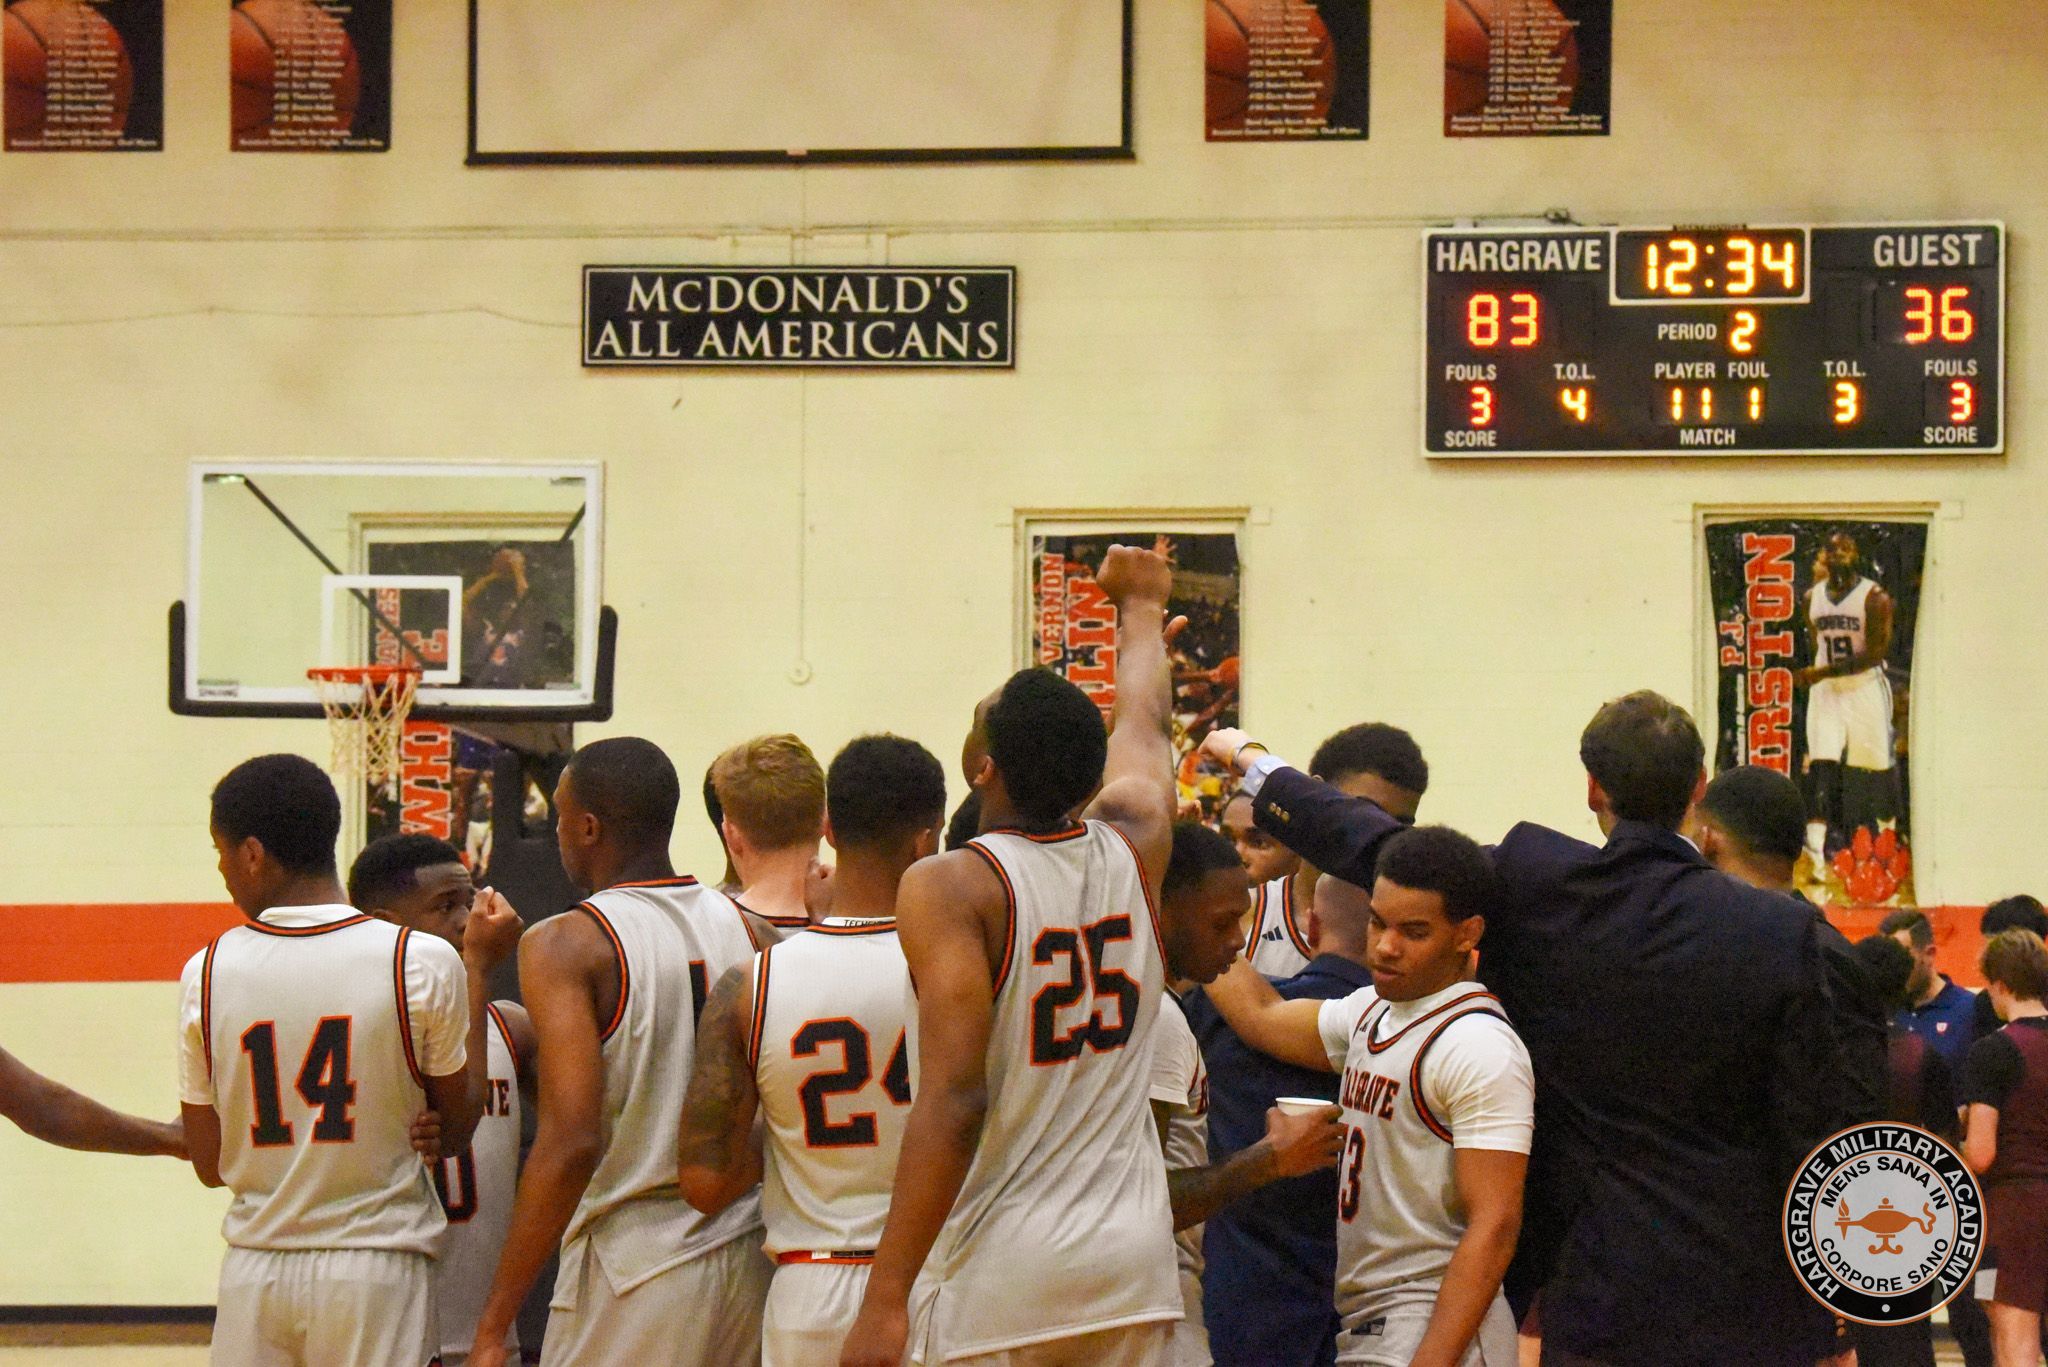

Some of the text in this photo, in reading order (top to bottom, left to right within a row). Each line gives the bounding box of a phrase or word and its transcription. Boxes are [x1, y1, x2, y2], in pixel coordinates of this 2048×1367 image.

[1436, 238, 1601, 273] HARGRAVE
[1646, 239, 1794, 293] 12:34
[1873, 233, 1983, 267] GUEST
[625, 274, 969, 314] McDONALD'S
[1468, 293, 1538, 347] 83
[1658, 322, 1718, 341] PERIOD
[1729, 310, 1756, 352] 2
[1905, 287, 1973, 342] 36
[593, 320, 999, 359] ALL AMERICANS
[1445, 363, 1498, 382] FOULS
[1654, 361, 1771, 379] PLAYER FOUL
[1924, 358, 1979, 377] FOULS
[1470, 385, 1492, 425] 3
[1561, 387, 1588, 422] 4
[1834, 381, 1858, 424] 3
[1950, 380, 1973, 422] 3
[1444, 429, 1498, 448] SCORE
[1679, 427, 1737, 446] MATCH
[1923, 425, 1979, 444] SCORE
[1039, 552, 1065, 666] VERNON
[1029, 912, 1141, 1068] 25
[239, 1014, 357, 1150] 14
